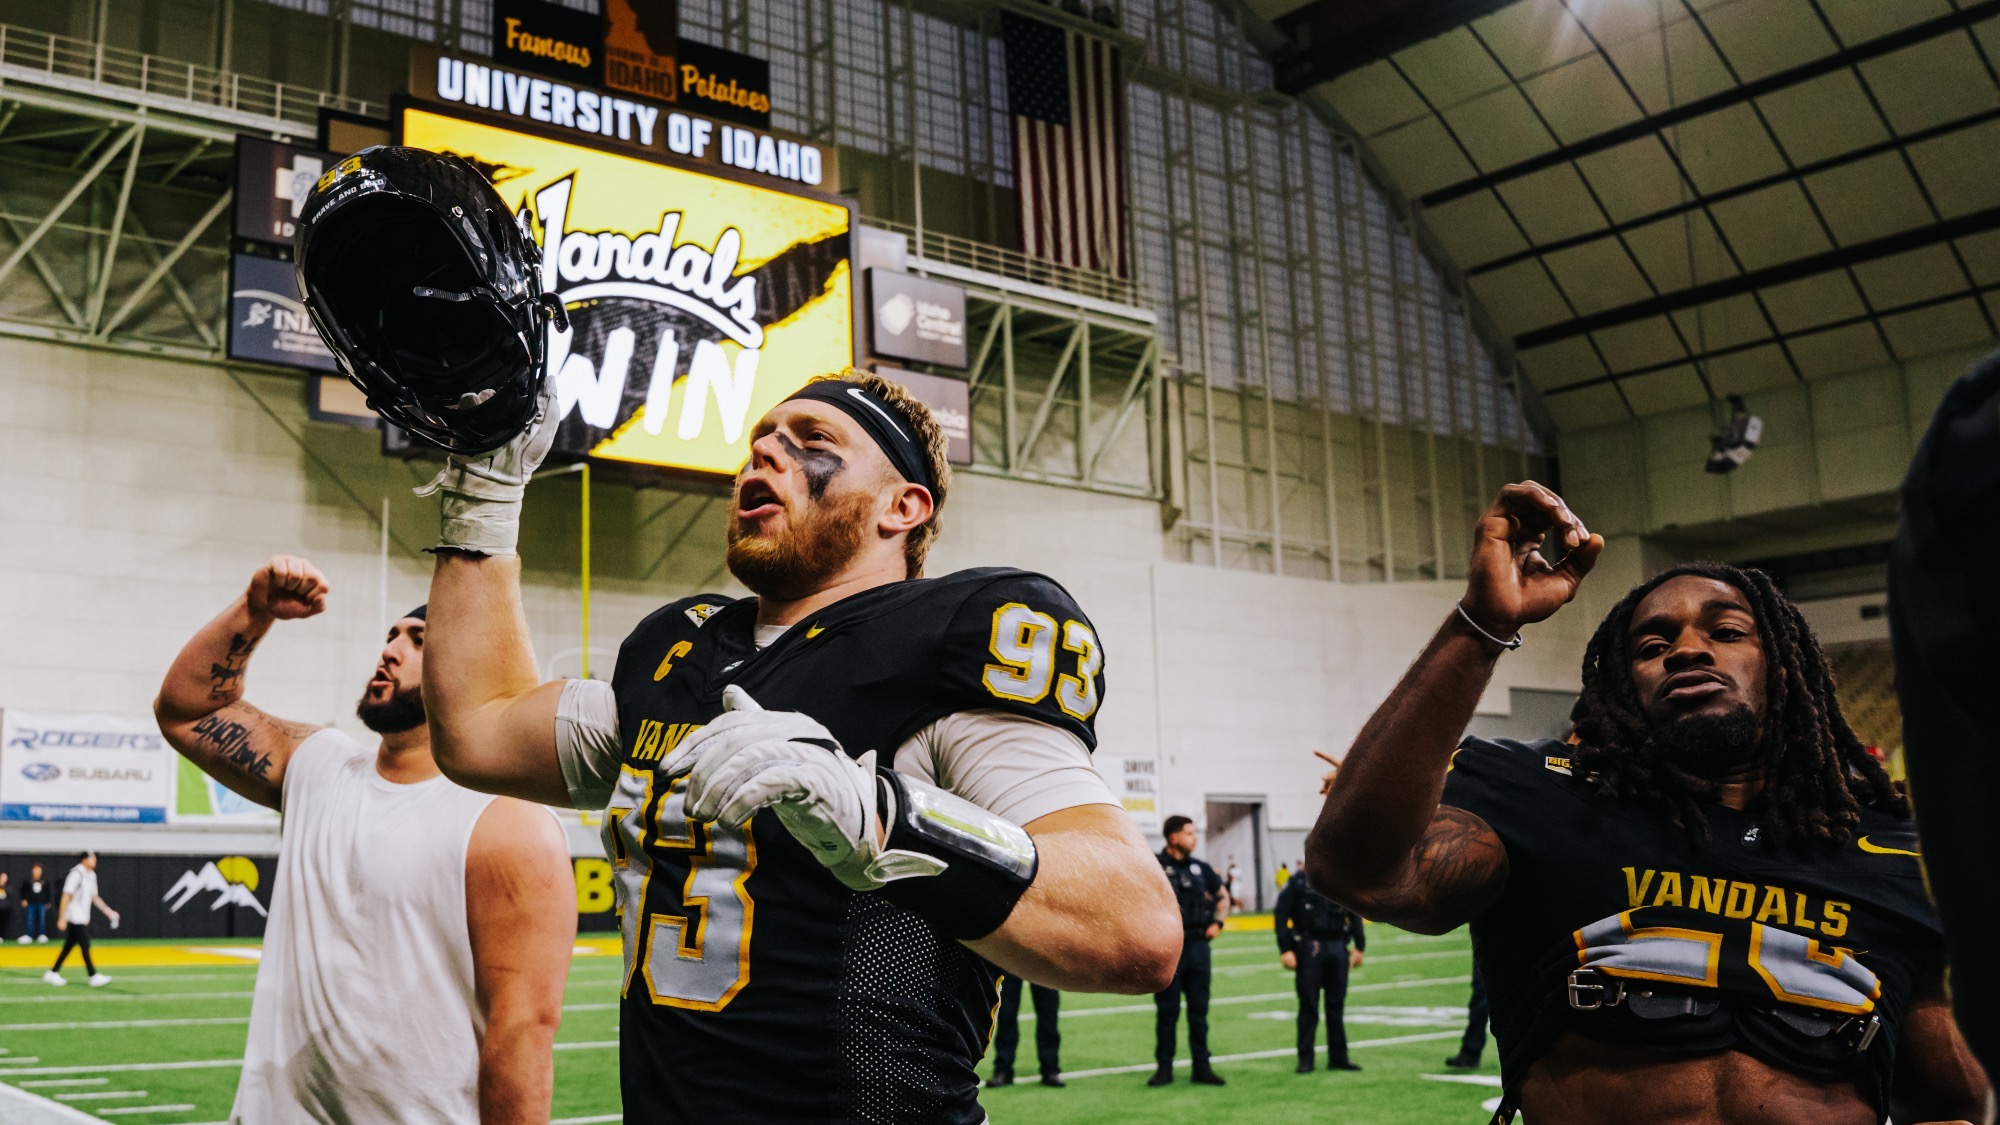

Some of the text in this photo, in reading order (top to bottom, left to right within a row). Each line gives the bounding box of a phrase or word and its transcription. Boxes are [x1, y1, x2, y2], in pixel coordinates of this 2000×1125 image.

[504, 17, 592, 68] Famous
[609, 60, 673, 97] IDAHO
[680, 64, 770, 113] Potatoes
[438, 56, 822, 185] UNIVERSITY OF IDAHO
[317, 156, 362, 193] 93
[311, 198, 336, 225] BRAVE
[338, 186, 357, 201] AND
[548, 322, 760, 445] WIN
[653, 640, 692, 682] C
[982, 602, 1101, 722] 93
[9, 728, 163, 751] ROGERS
[68, 767, 152, 782] SUBARU
[1125, 761, 1155, 774] DRIVE
[1548, 757, 1571, 769] BIG
[601, 763, 757, 1013] 93
[1621, 866, 1852, 938] VANDALS
